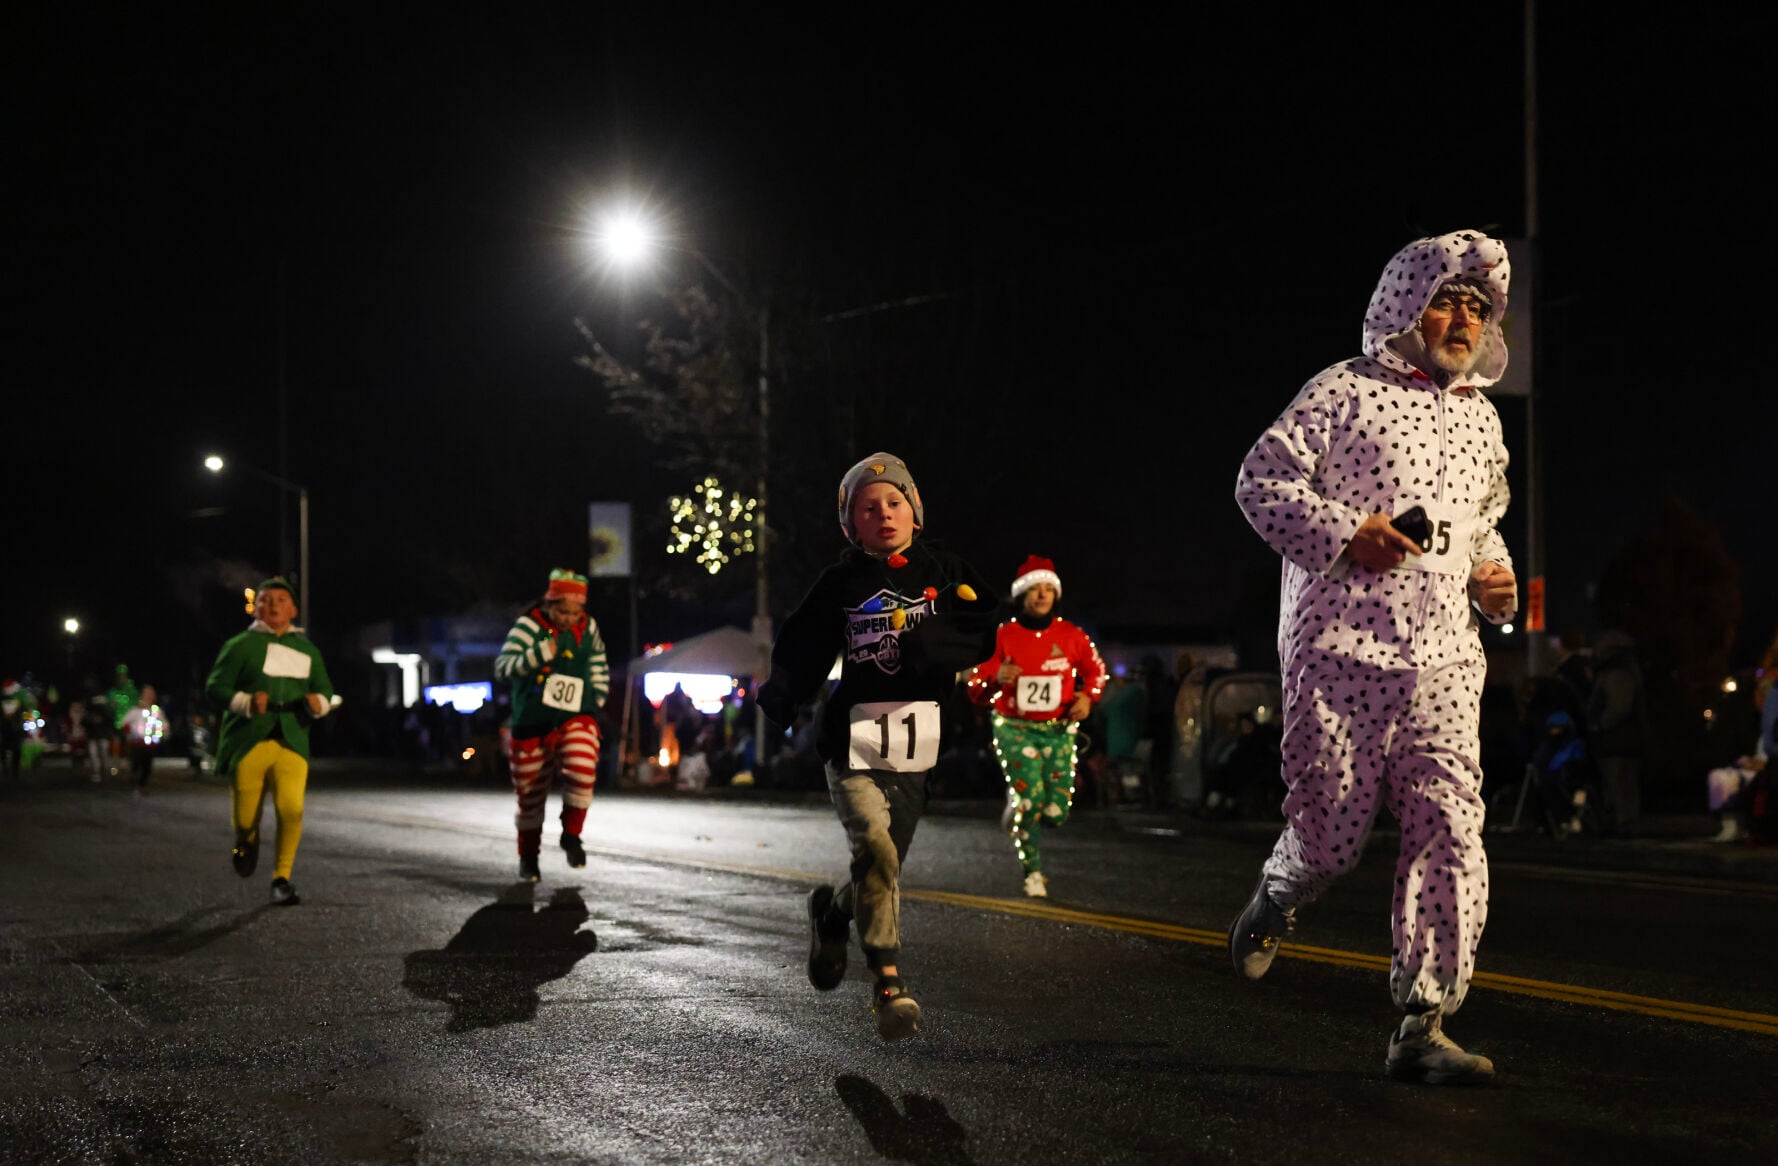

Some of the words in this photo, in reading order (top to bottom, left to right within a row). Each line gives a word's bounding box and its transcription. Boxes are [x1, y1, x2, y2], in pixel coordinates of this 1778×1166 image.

[853, 612, 924, 636] SUPERW
[552, 680, 576, 703] 30
[1027, 682, 1050, 704] 24
[874, 713, 916, 760] 11
